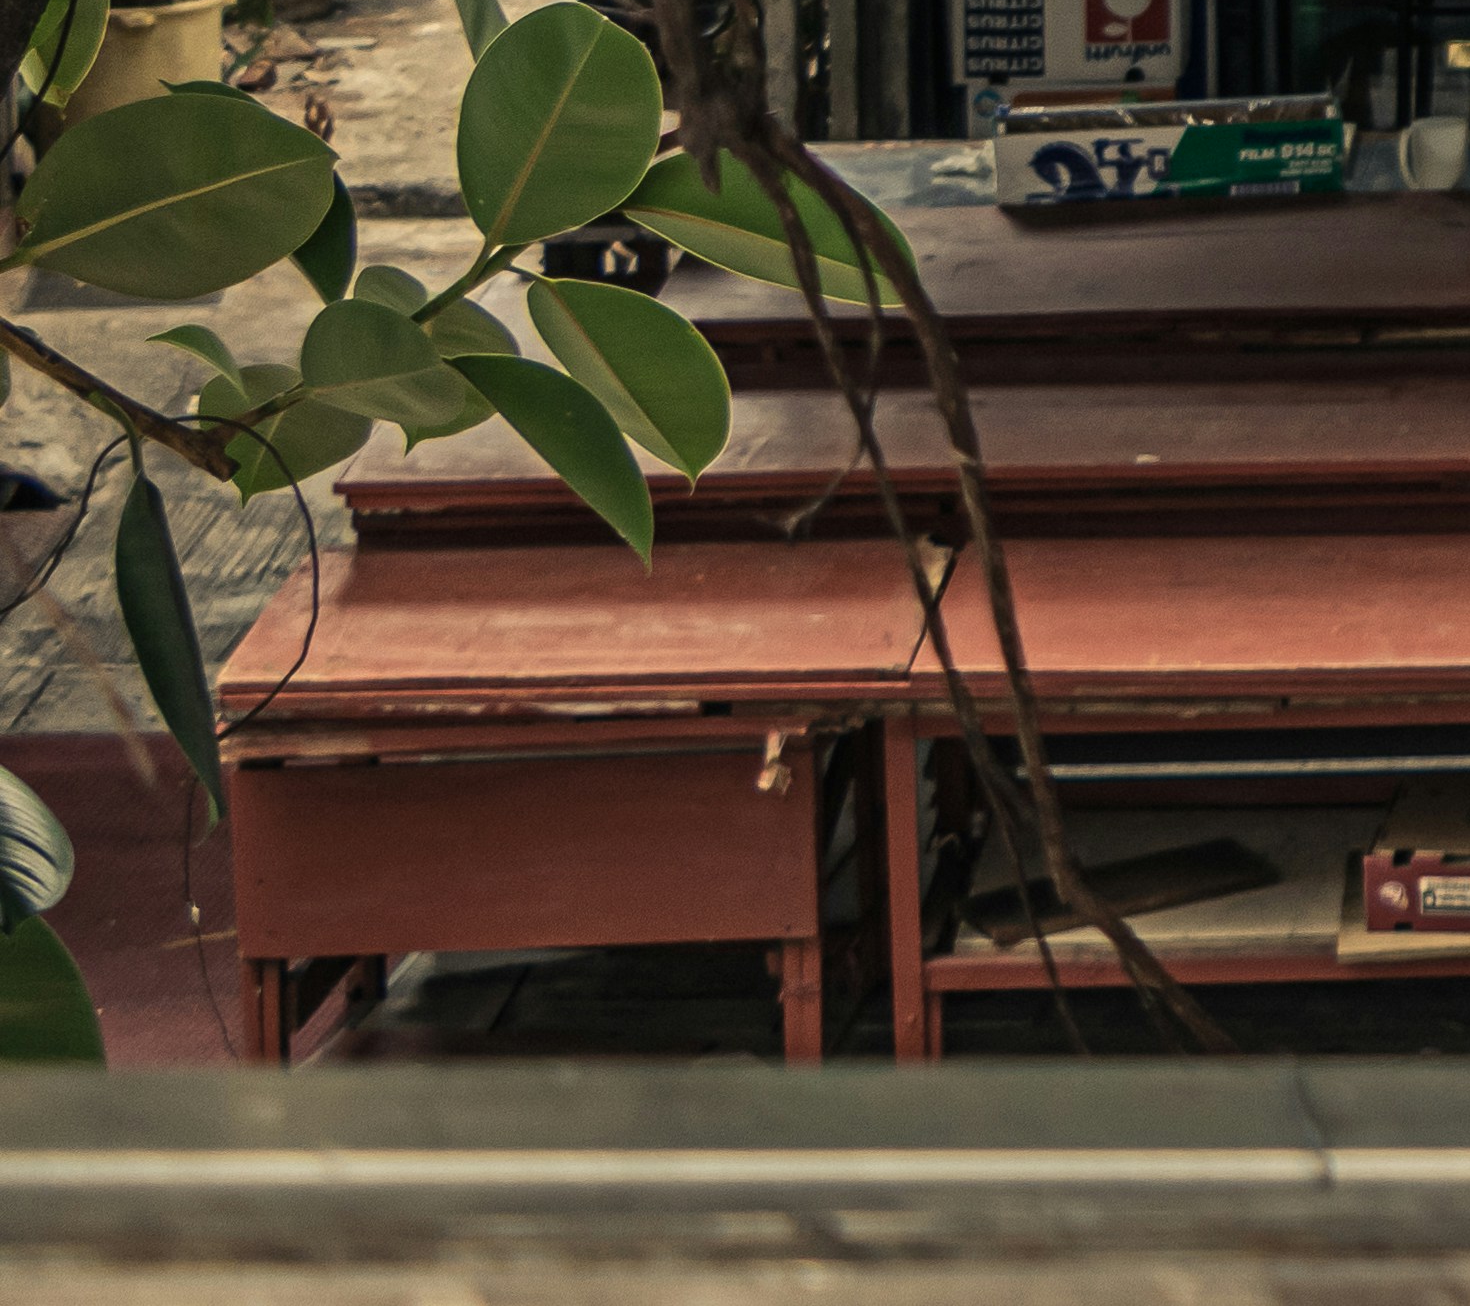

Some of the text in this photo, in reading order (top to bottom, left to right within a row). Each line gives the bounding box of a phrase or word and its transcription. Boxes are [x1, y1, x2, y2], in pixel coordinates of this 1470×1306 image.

[966, 14, 1043, 30] CITRUS
[966, 35, 1043, 51] CITRUS
[1085, 44, 1171, 65] unifrutti
[966, 57, 1043, 73] CITRUS
[1238, 147, 1276, 161] FILM
